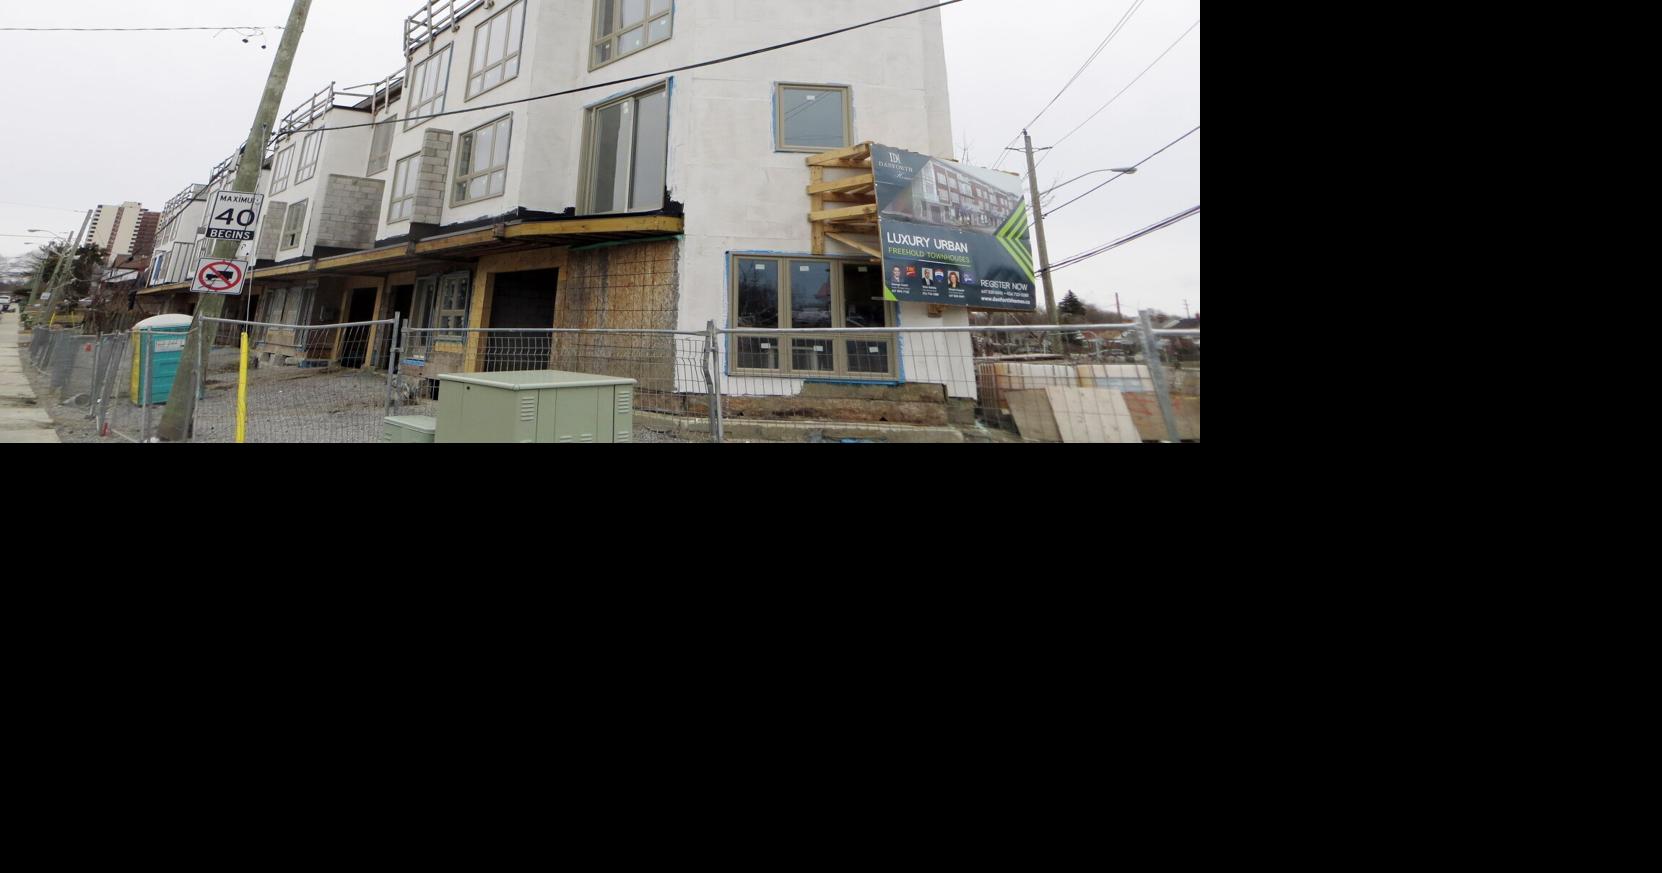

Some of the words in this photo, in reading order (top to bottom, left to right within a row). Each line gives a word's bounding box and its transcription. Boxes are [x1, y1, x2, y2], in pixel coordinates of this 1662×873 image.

[220, 195, 255, 204] MAXIMU
[214, 207, 255, 227] 40
[210, 229, 251, 240] BEGINS
[886, 231, 930, 248] LUXURY
[933, 238, 969, 254] URBAN
[888, 246, 926, 258] FREEHOLD
[927, 251, 971, 264] TOWNHOUSES
[980, 279, 1011, 290] REGISTER
[1011, 282, 1029, 291] NOW
